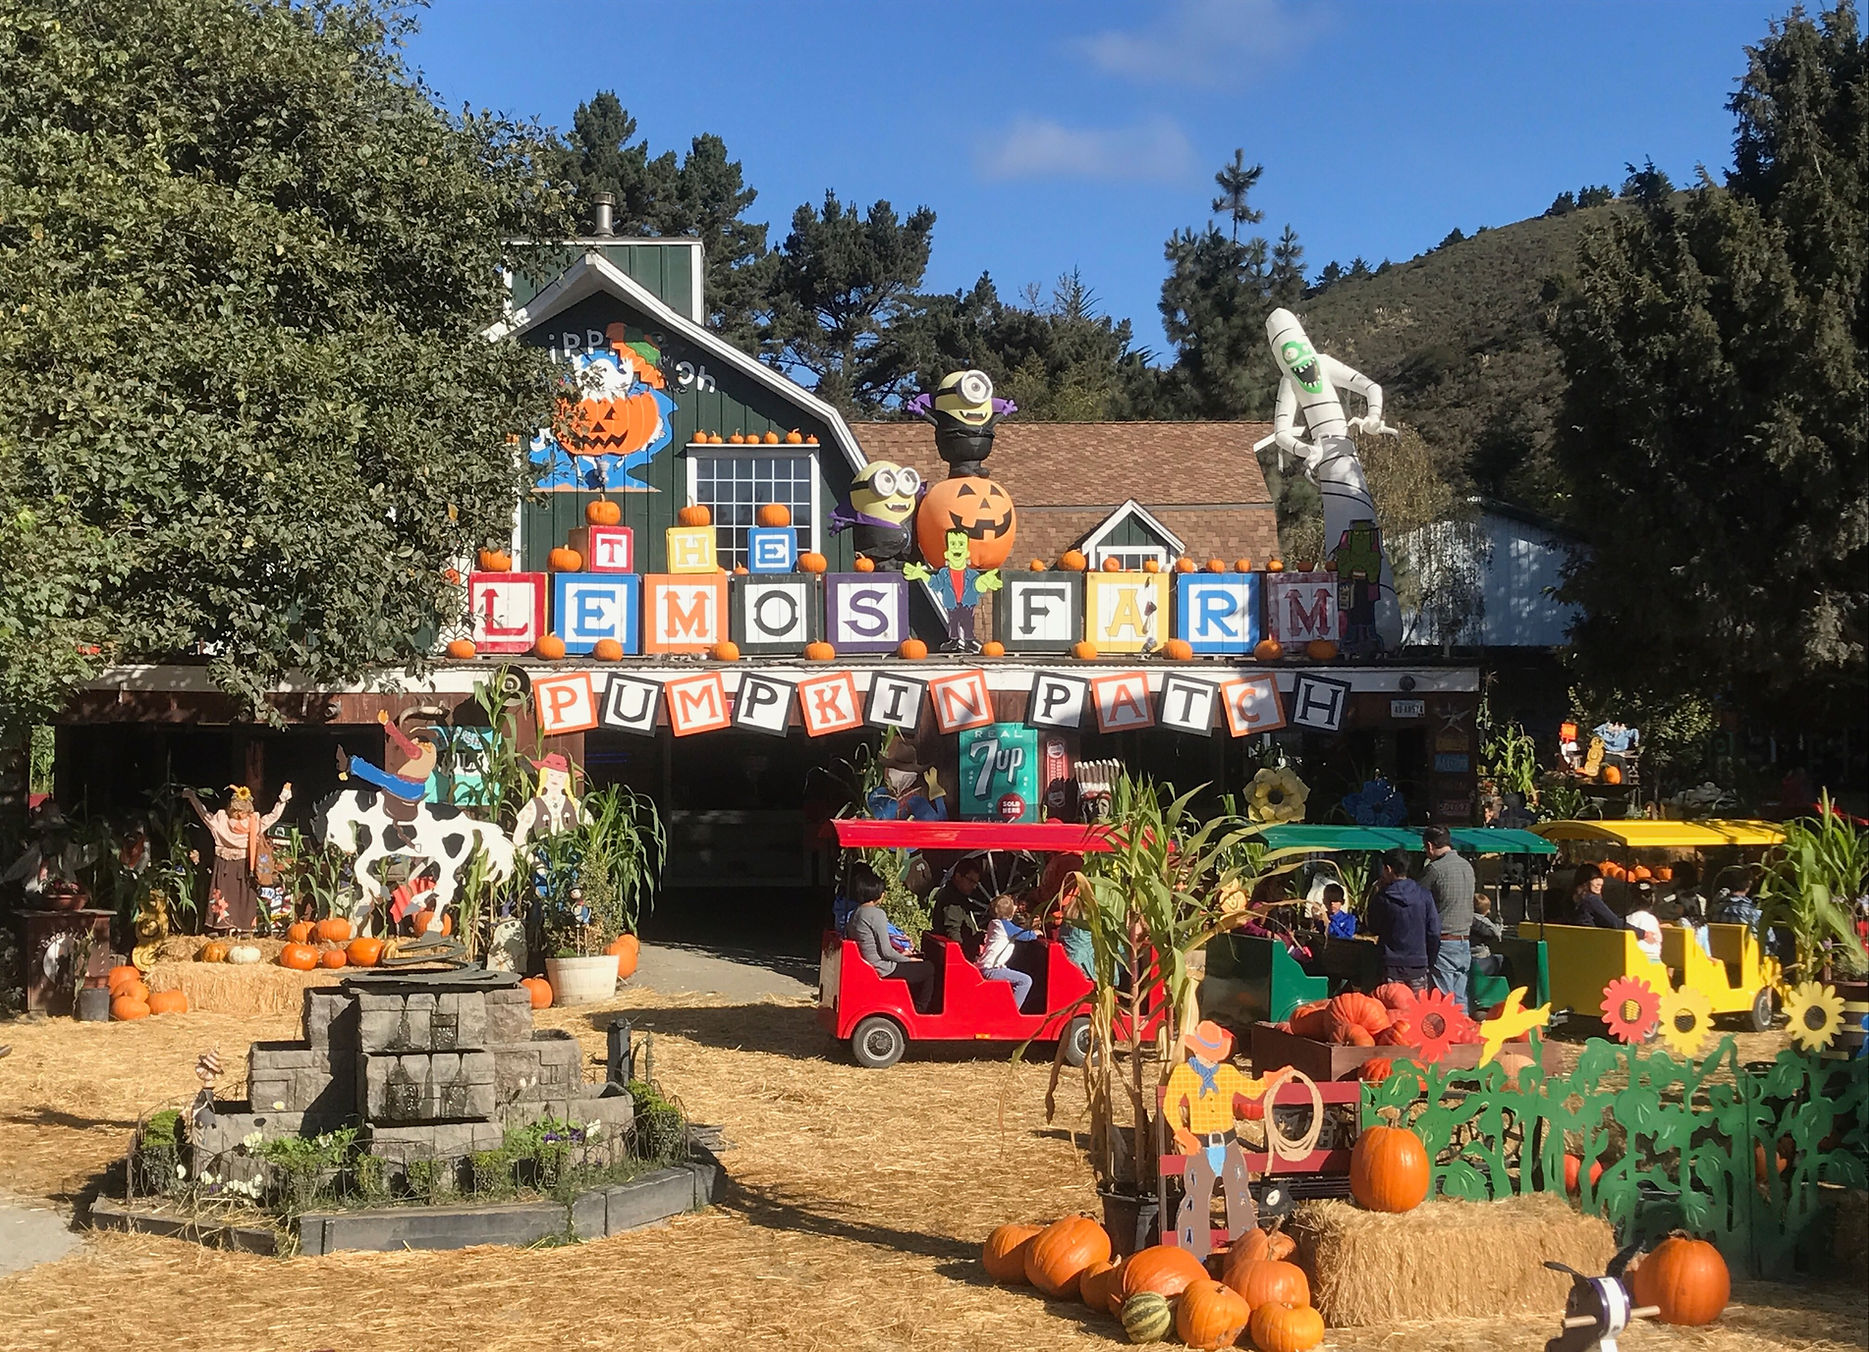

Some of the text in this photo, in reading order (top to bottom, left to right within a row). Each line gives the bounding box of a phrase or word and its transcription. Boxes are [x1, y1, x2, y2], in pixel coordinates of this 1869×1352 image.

[600, 532, 789, 568] THE
[479, 588, 890, 637] LEMOS
[1018, 587, 1333, 638] FARM
[547, 680, 1343, 725] PUMPKIN PATCH
[974, 730, 1023, 738] REAL
[1002, 800, 1020, 808] SOLD
